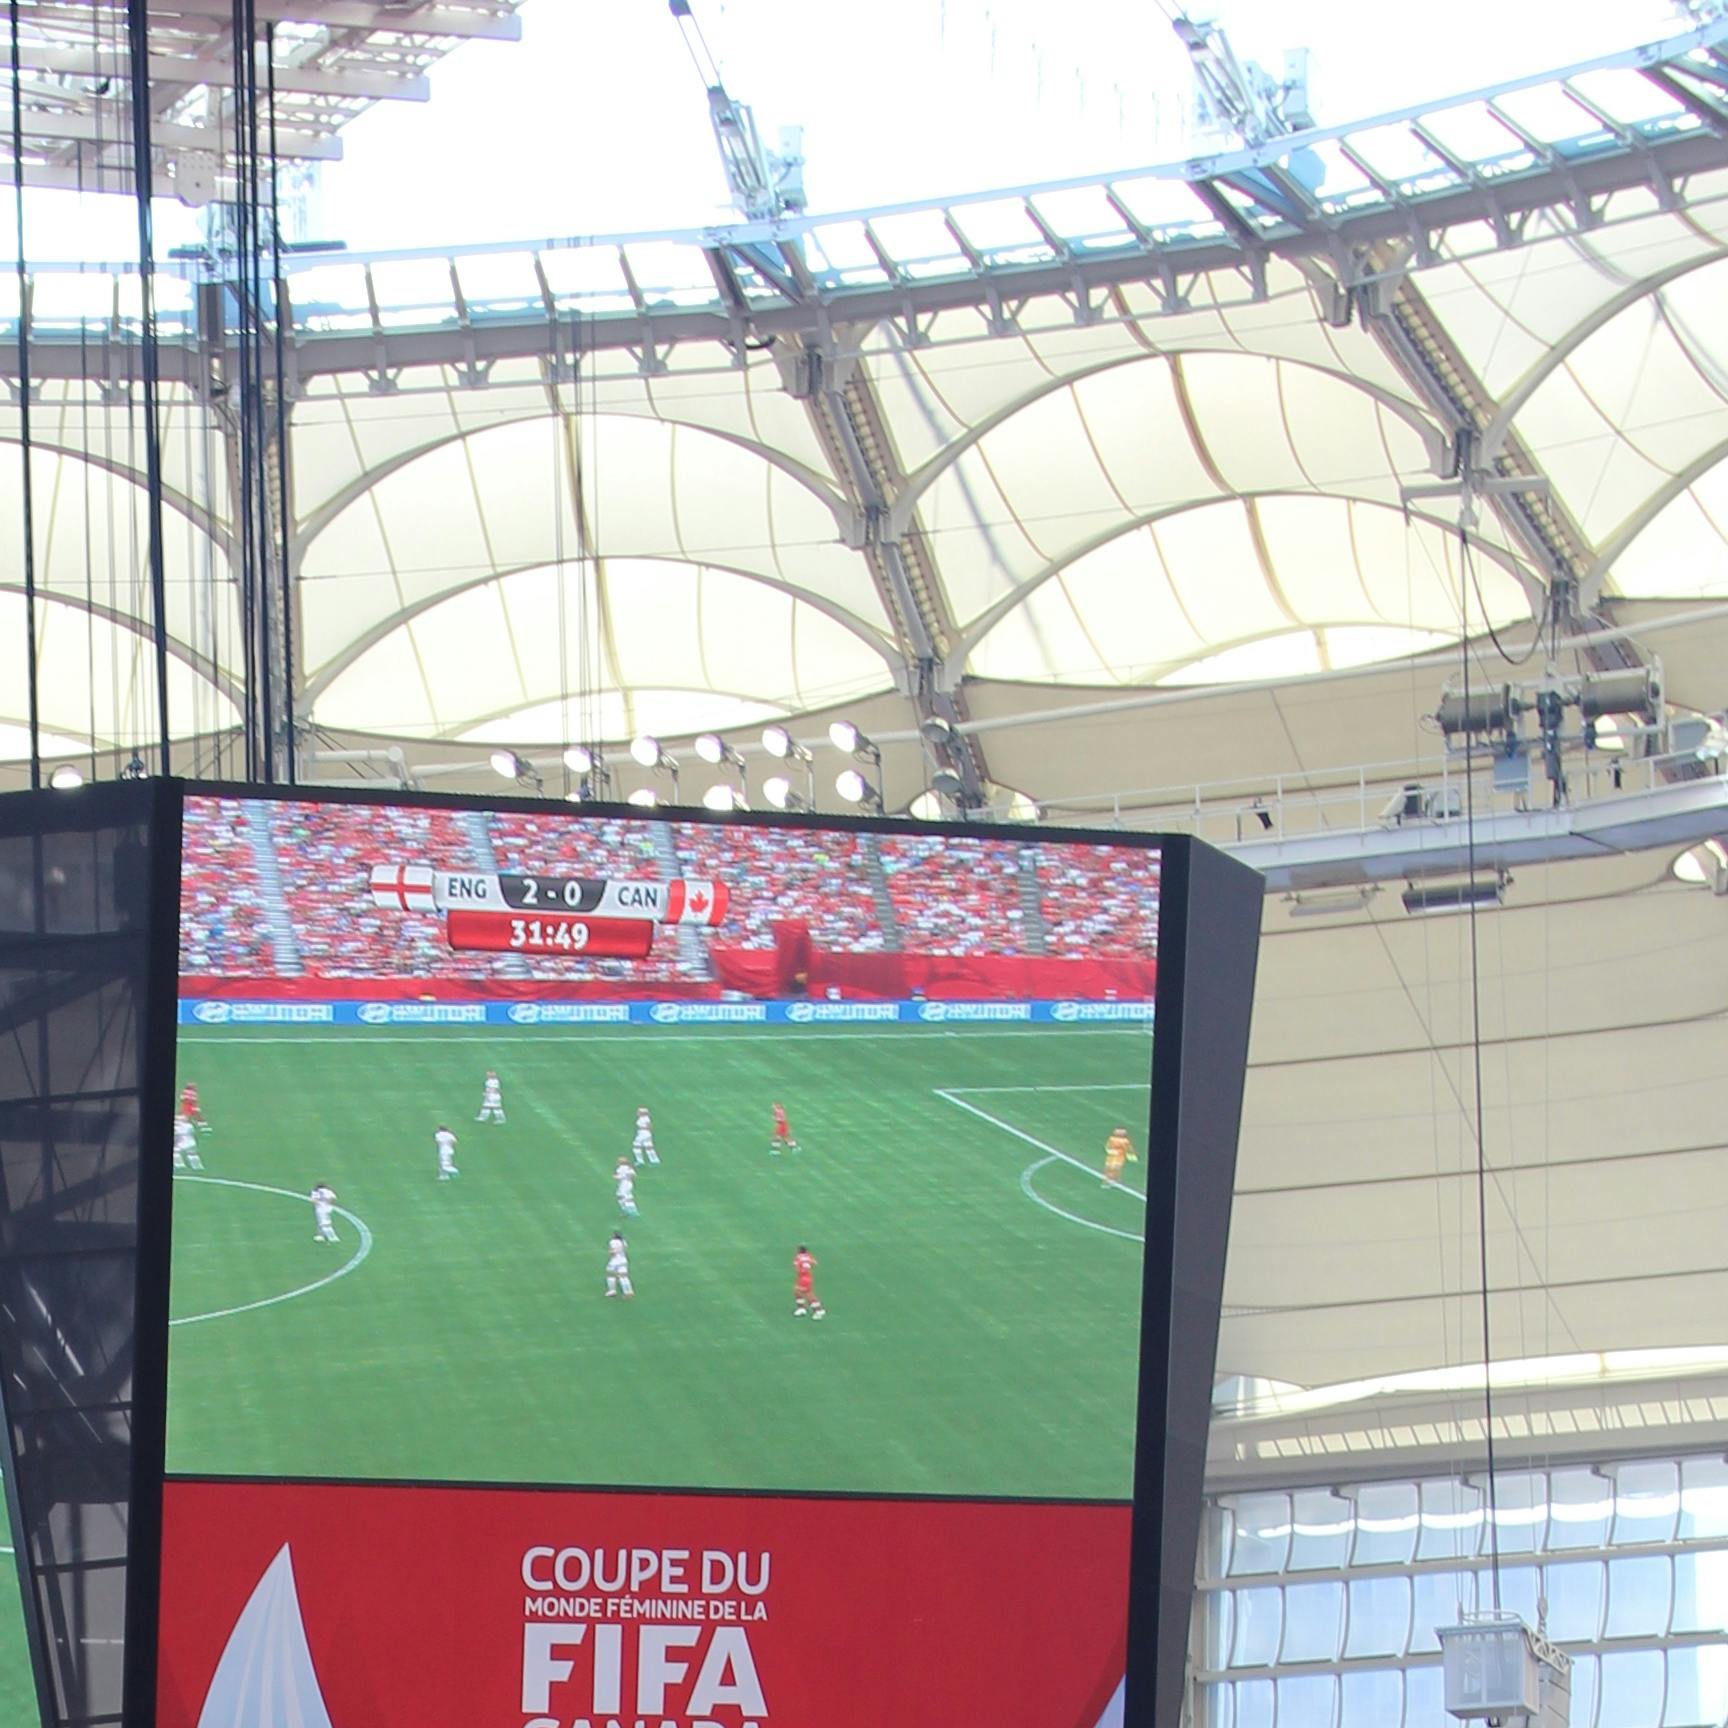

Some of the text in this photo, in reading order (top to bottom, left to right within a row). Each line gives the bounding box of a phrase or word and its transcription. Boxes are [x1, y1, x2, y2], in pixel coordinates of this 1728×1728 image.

[447, 877, 487, 899] ENG
[617, 886, 658, 908] CAN
[509, 919, 589, 949] 31:49
[521, 1546, 771, 1595] COUPE DU
[524, 1594, 768, 1621] MONDE FÉMININE DE LA
[521, 1622, 769, 1718] FIFA
